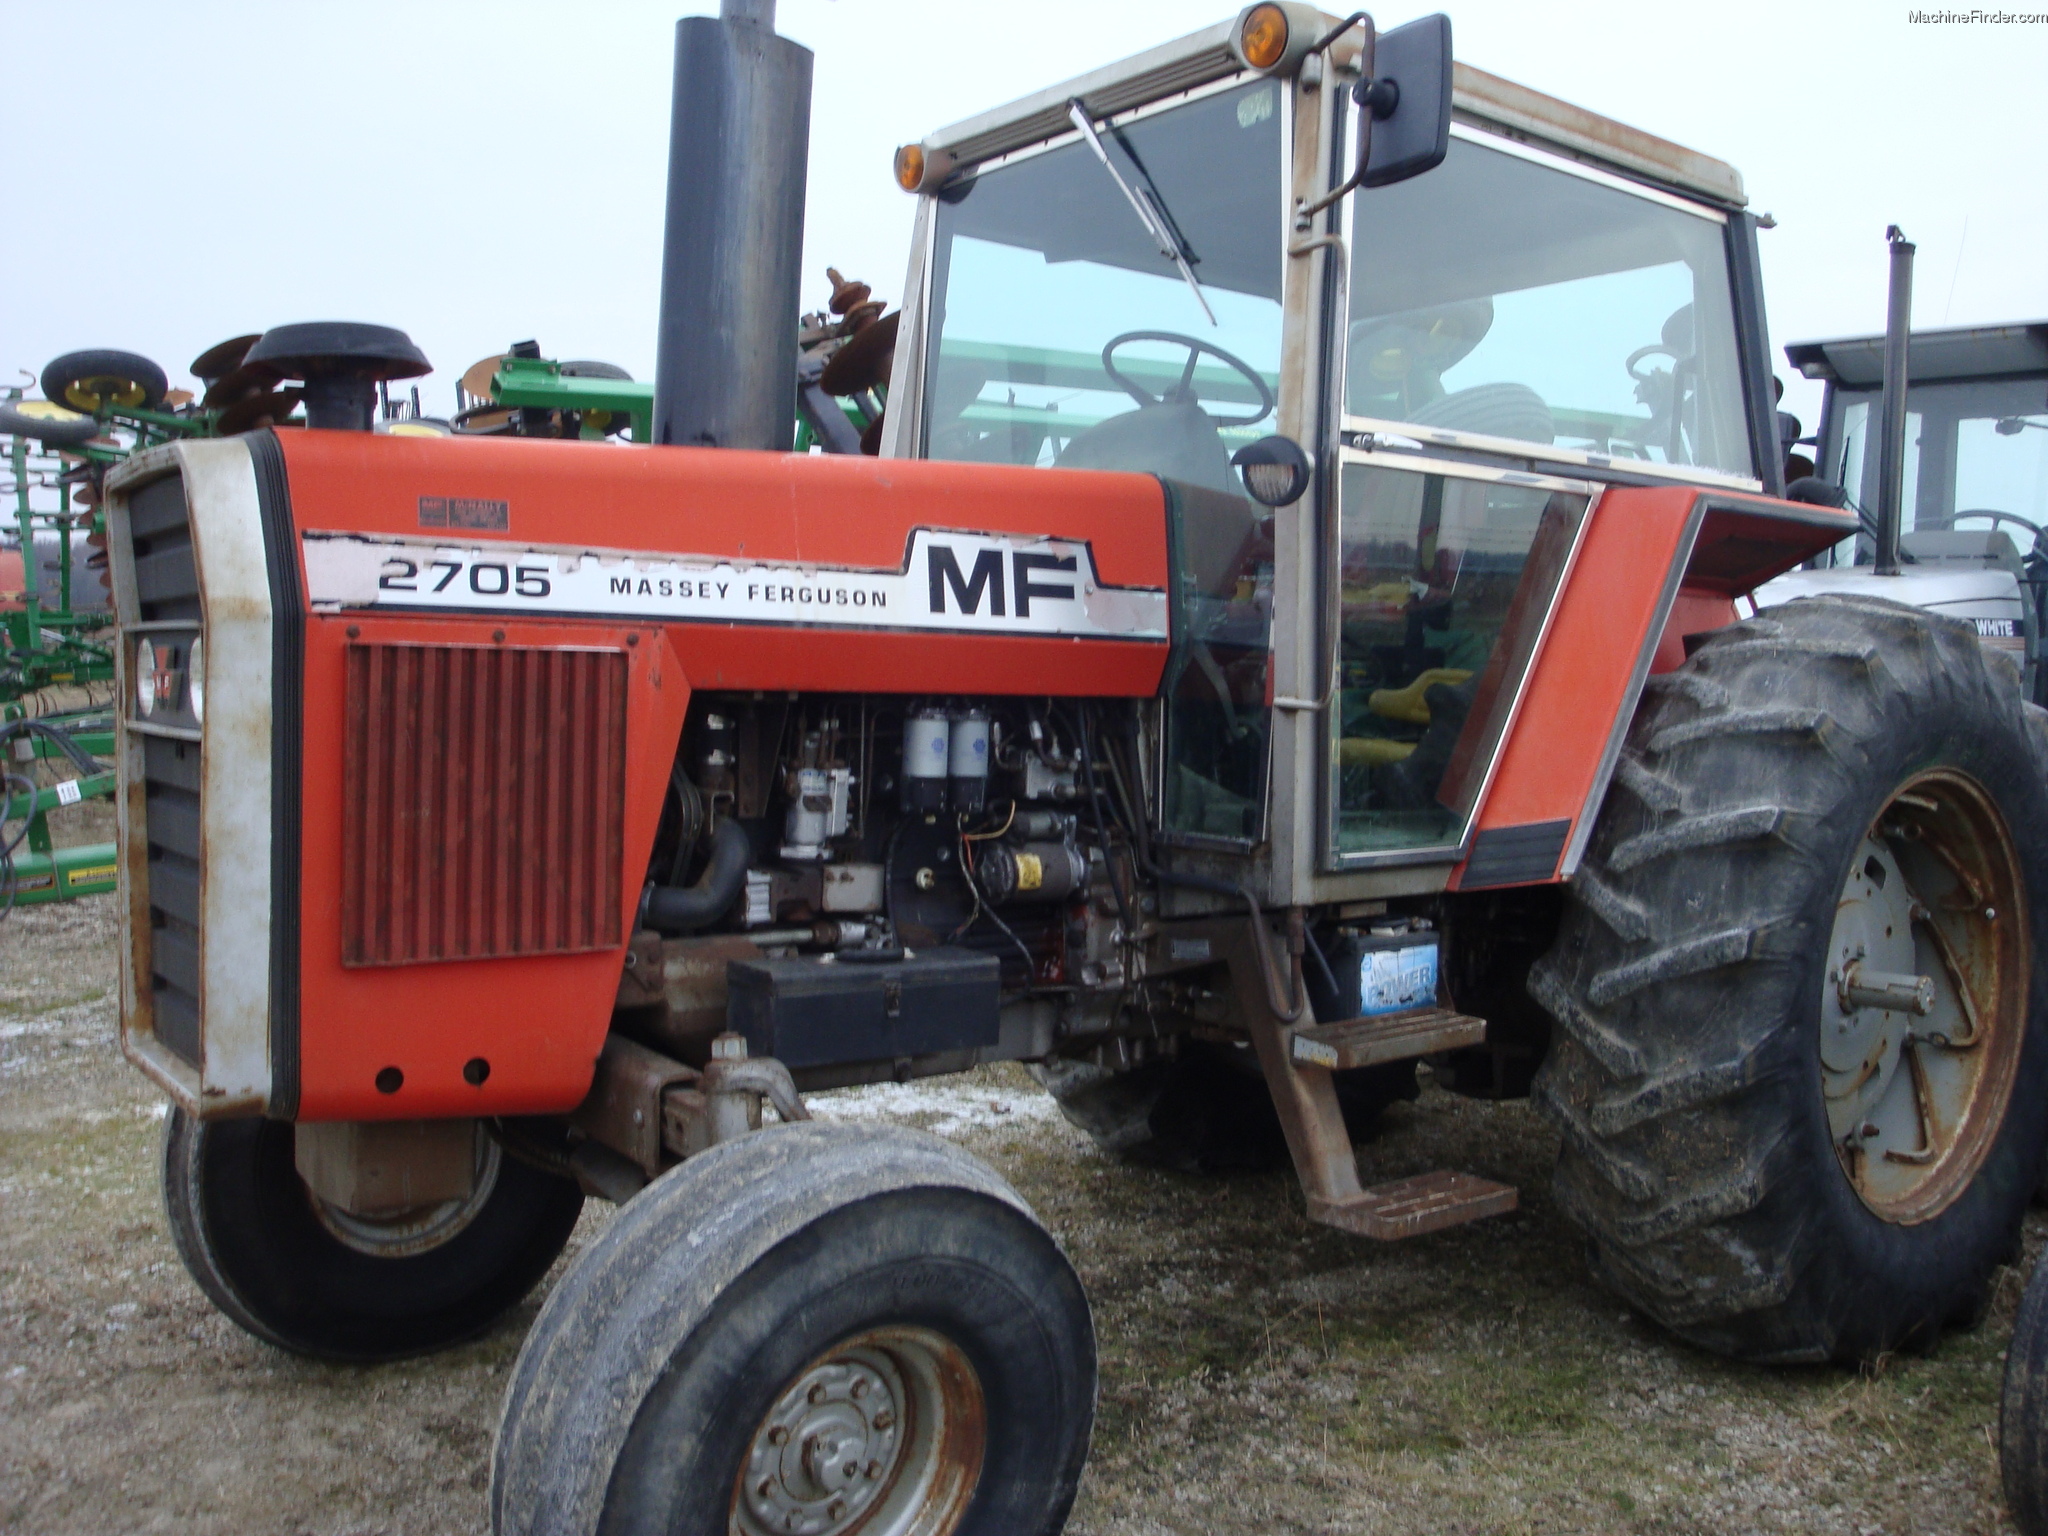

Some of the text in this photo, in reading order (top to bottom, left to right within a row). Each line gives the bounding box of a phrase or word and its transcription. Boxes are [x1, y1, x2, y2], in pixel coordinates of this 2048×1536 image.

[378, 559, 551, 597] 2705
[609, 576, 888, 608] MASSEY FERGUSON
[927, 545, 1077, 618] MF
[1975, 619, 2013, 636] WHITE
[1367, 965, 1431, 1004] POWER
